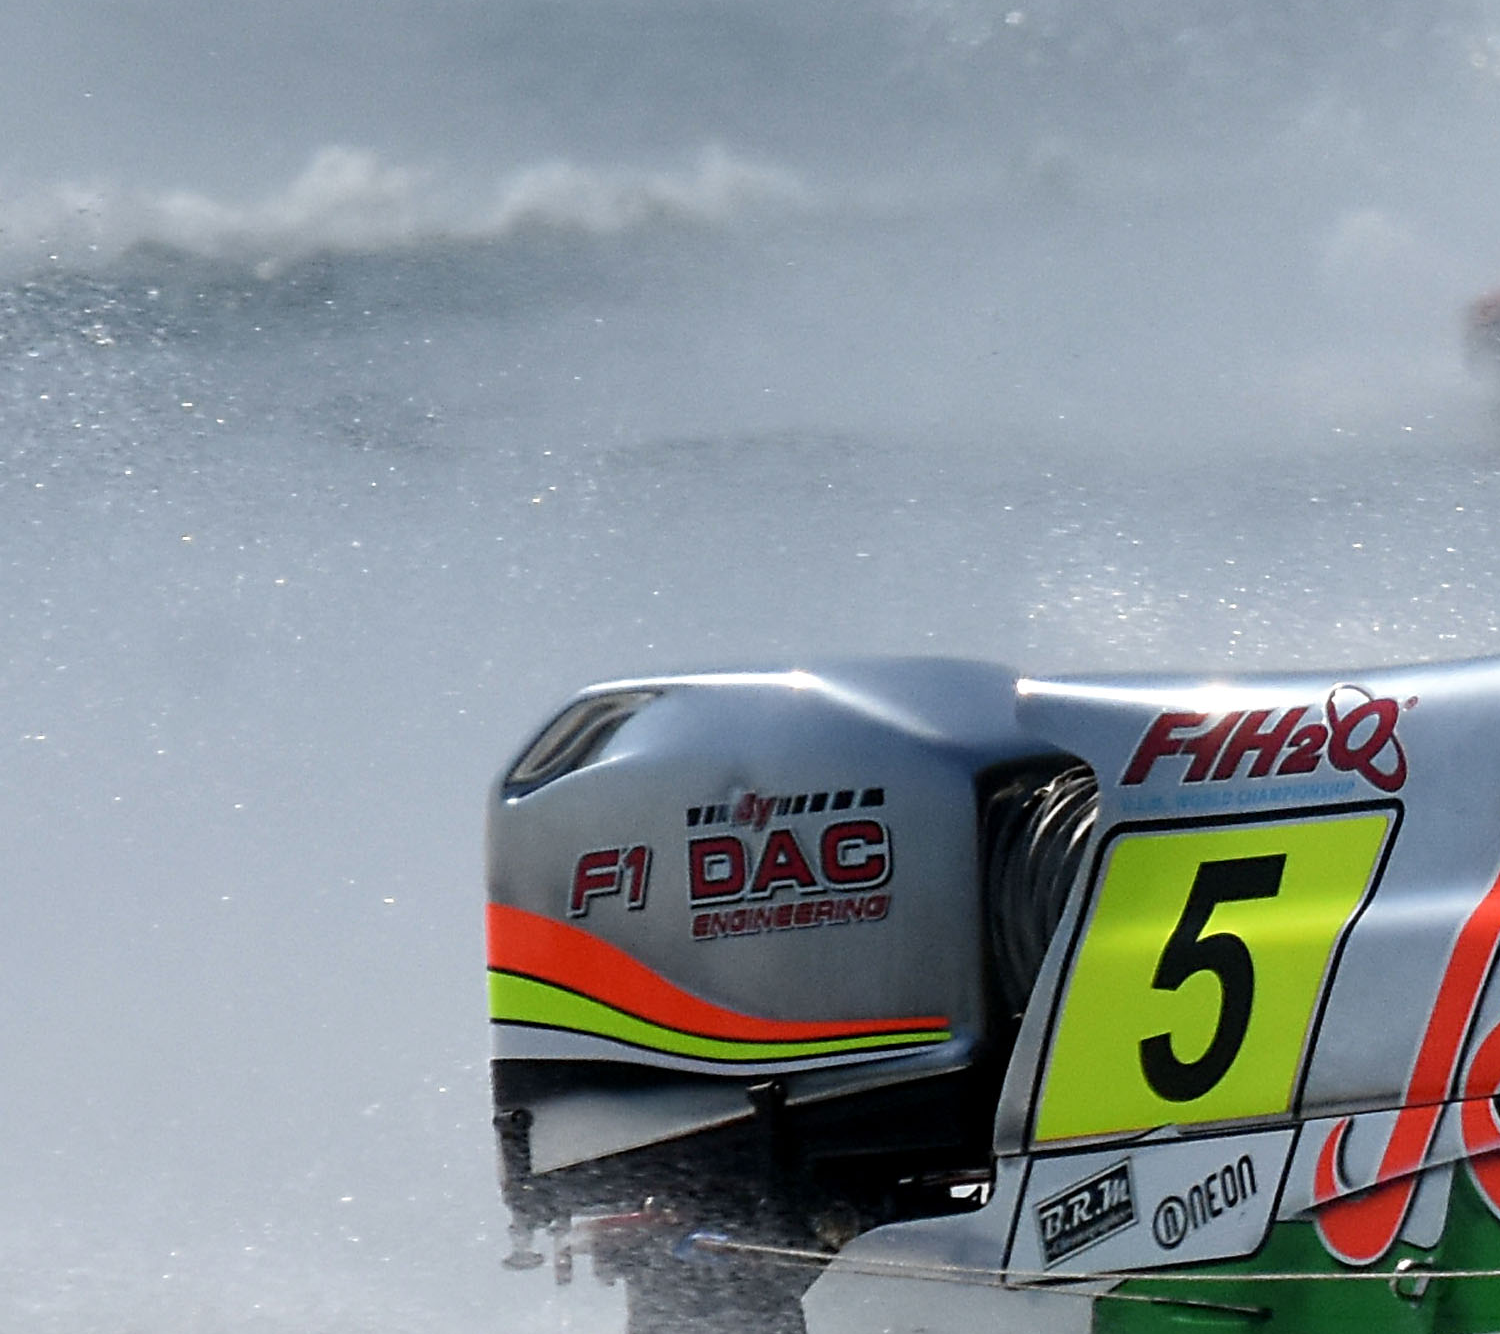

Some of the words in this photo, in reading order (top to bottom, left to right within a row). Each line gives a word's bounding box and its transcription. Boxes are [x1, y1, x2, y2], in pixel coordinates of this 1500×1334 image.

[566, 841, 653, 919] F1
[687, 817, 894, 911] DAC
[689, 893, 893, 943] ENGINEERING
[1138, 852, 1288, 1102] 5
